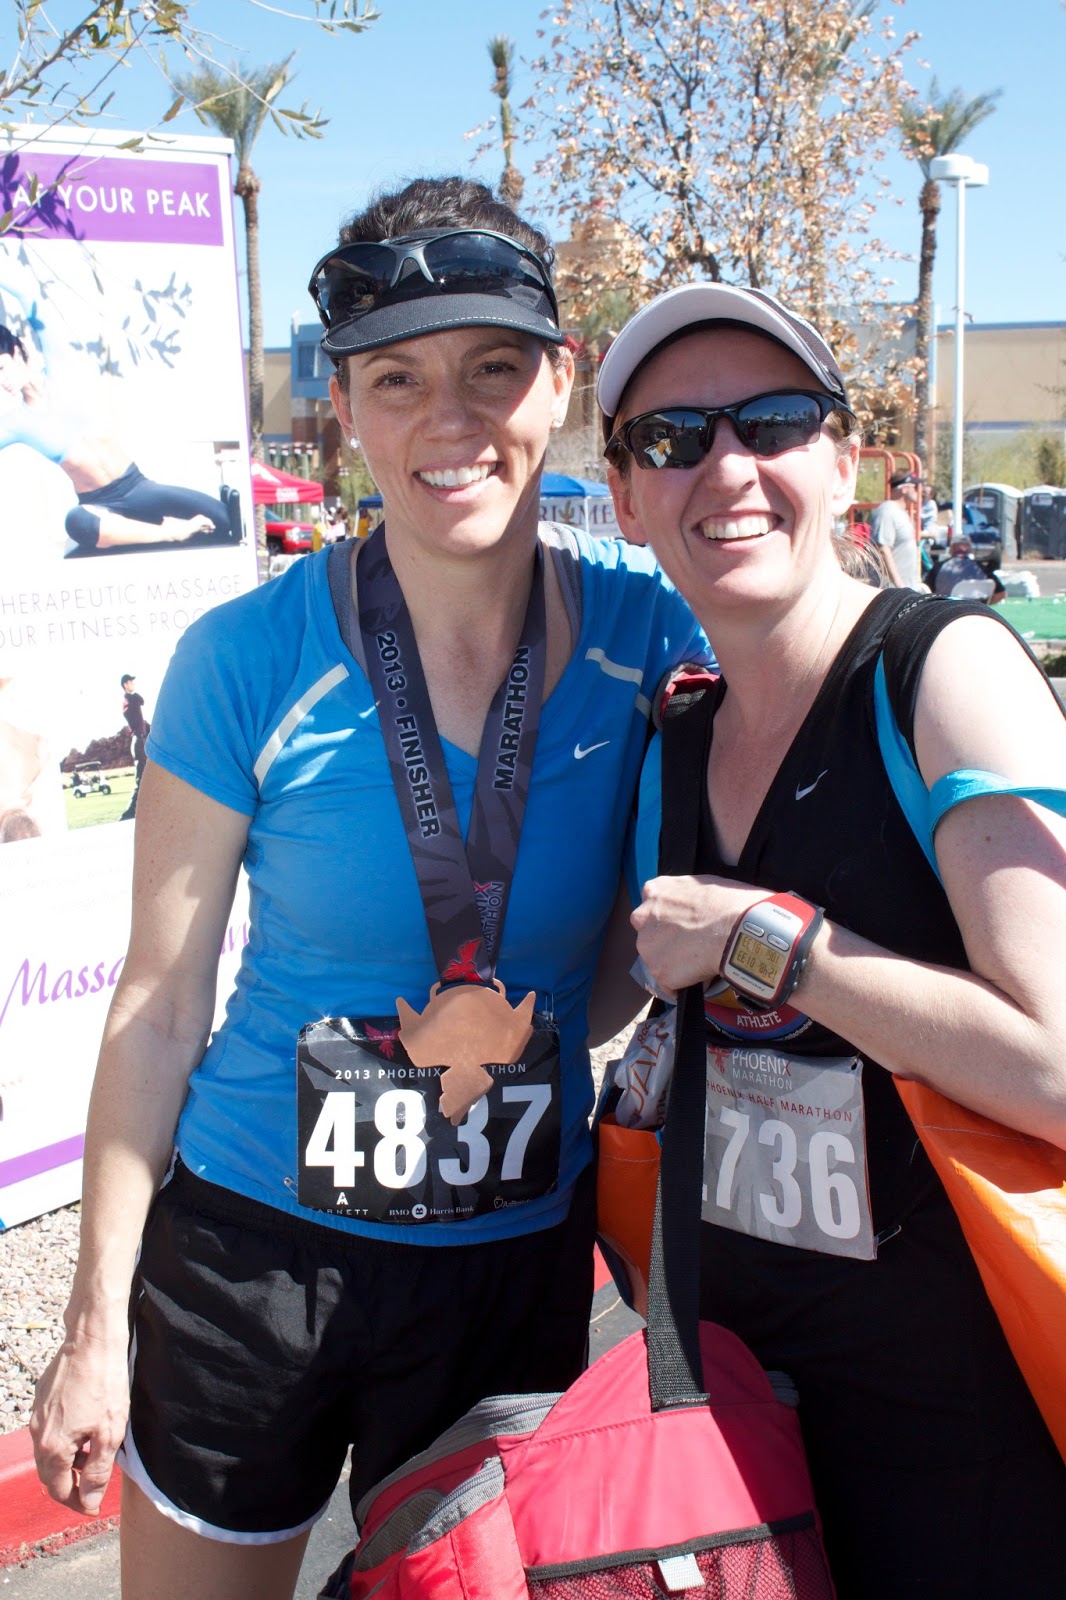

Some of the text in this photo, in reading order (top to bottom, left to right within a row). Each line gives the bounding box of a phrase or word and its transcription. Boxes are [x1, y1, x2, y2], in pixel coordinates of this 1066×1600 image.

[57, 184, 135, 214] YOUR
[146, 189, 211, 218] PEAK
[0, 575, 241, 616] HERAPEUTIC MASSAGE
[48, 614, 139, 643] FITNESS
[493, 646, 529, 791] MARATHON
[377, 631, 441, 839] 2013 FINISHER
[0, 954, 126, 1026] Mass
[736, 1011, 781, 1028] ATHLETE
[335, 1063, 526, 1080] 2013 PHOENIX THON
[732, 1049, 792, 1077] PHOENIX
[732, 1068, 793, 1090] MARATHON
[749, 1093, 775, 1107] HALF
[780, 1100, 852, 1122] MARATHON
[305, 1083, 553, 1189] 4837
[702, 1105, 861, 1240] 736
[430, 1207, 455, 1215] Harris
[455, 1205, 475, 1213] Bank
